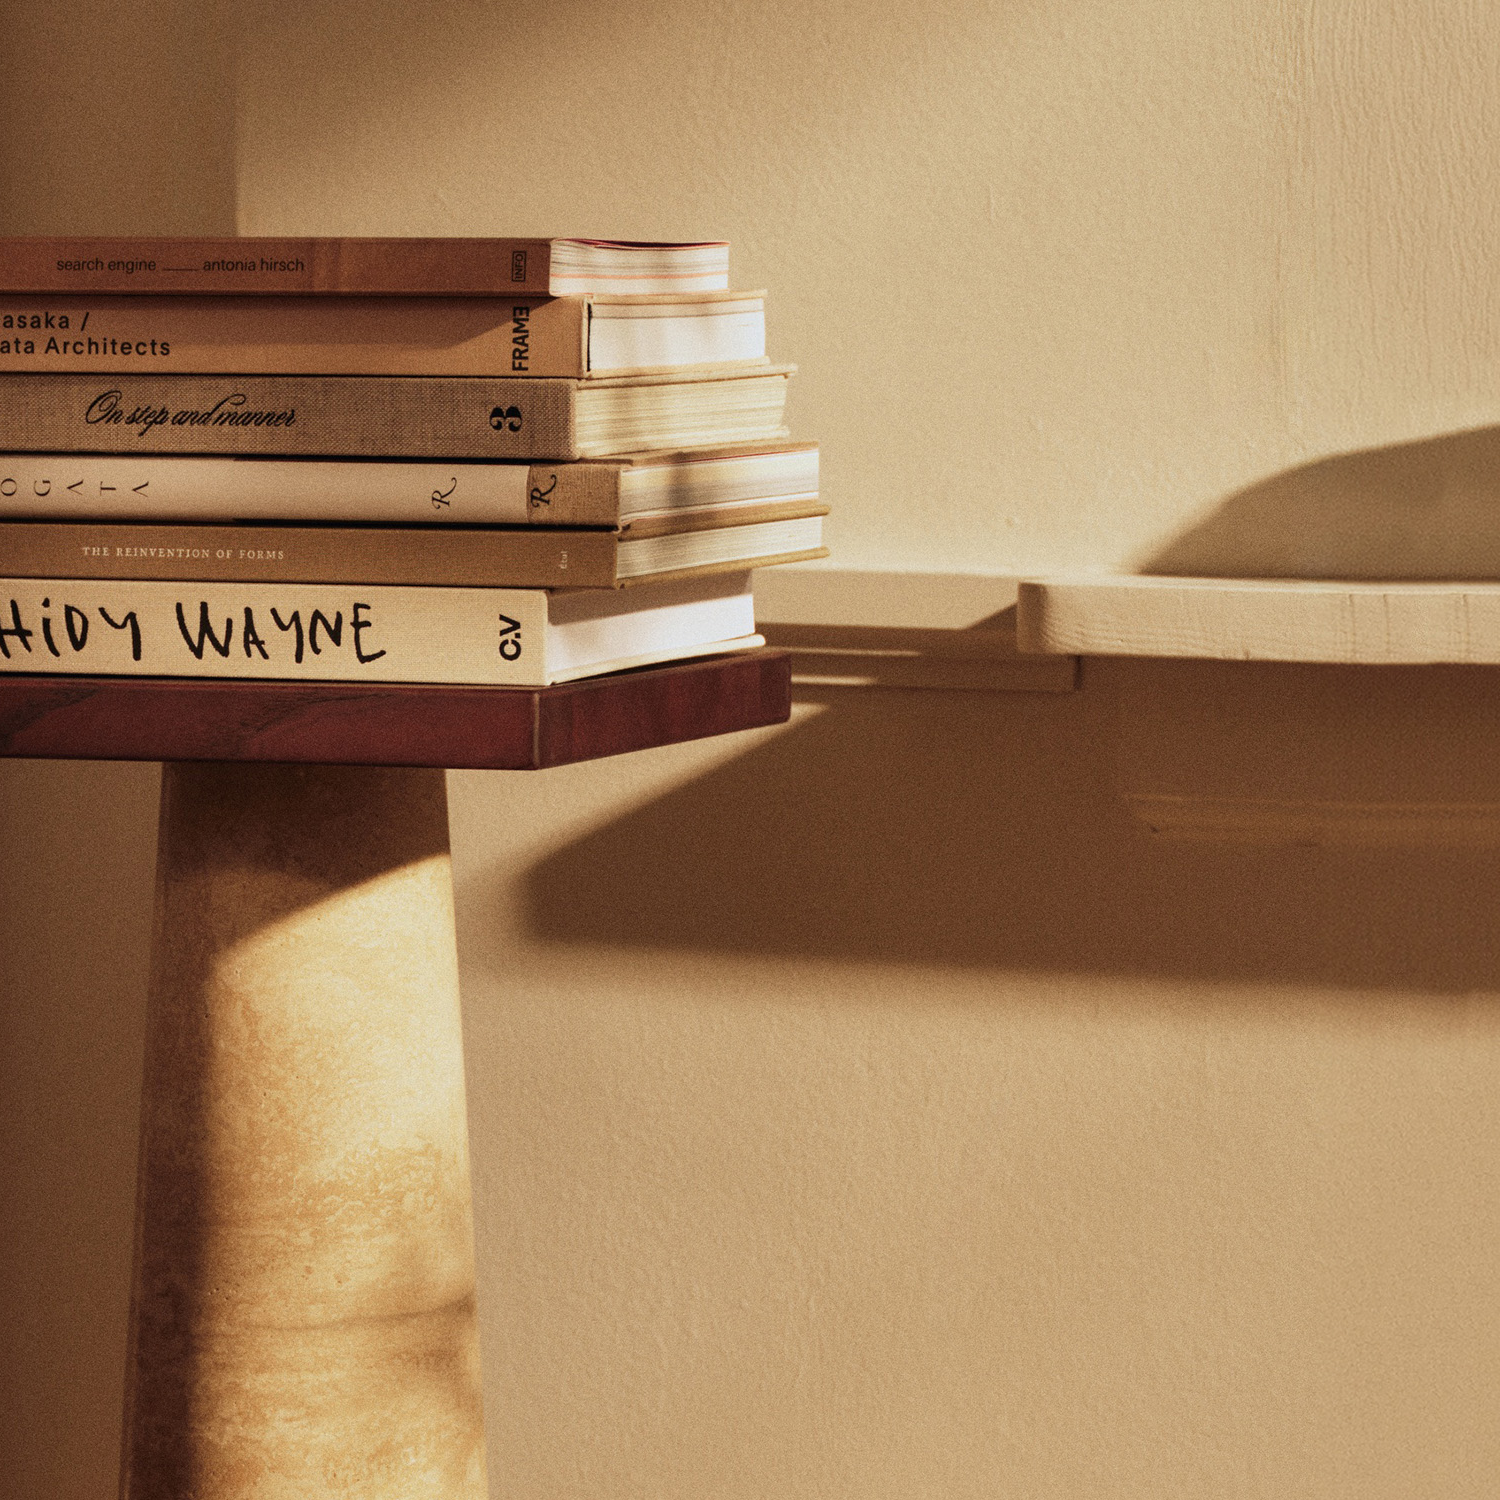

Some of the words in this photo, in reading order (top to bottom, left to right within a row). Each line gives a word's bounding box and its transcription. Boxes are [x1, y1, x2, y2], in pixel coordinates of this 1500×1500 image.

[56, 257, 105, 272] search
[108, 258, 157, 275] engine
[202, 257, 257, 272] antonia
[259, 257, 306, 272] hirsch
[514, 253, 525, 280] INFO
[45, 336, 171, 356] Architects
[85, 390, 123, 425] On
[124, 405, 170, 437] step
[212, 408, 297, 427] manner
[431, 476, 457, 510] R
[530, 473, 557, 508] R
[82, 547, 109, 557] THE
[116, 548, 210, 559] REINVENTION
[215, 549, 233, 560] OF
[239, 550, 285, 561] FORMS
[175, 600, 387, 665] WAYNE
[498, 613, 522, 661] C.V
